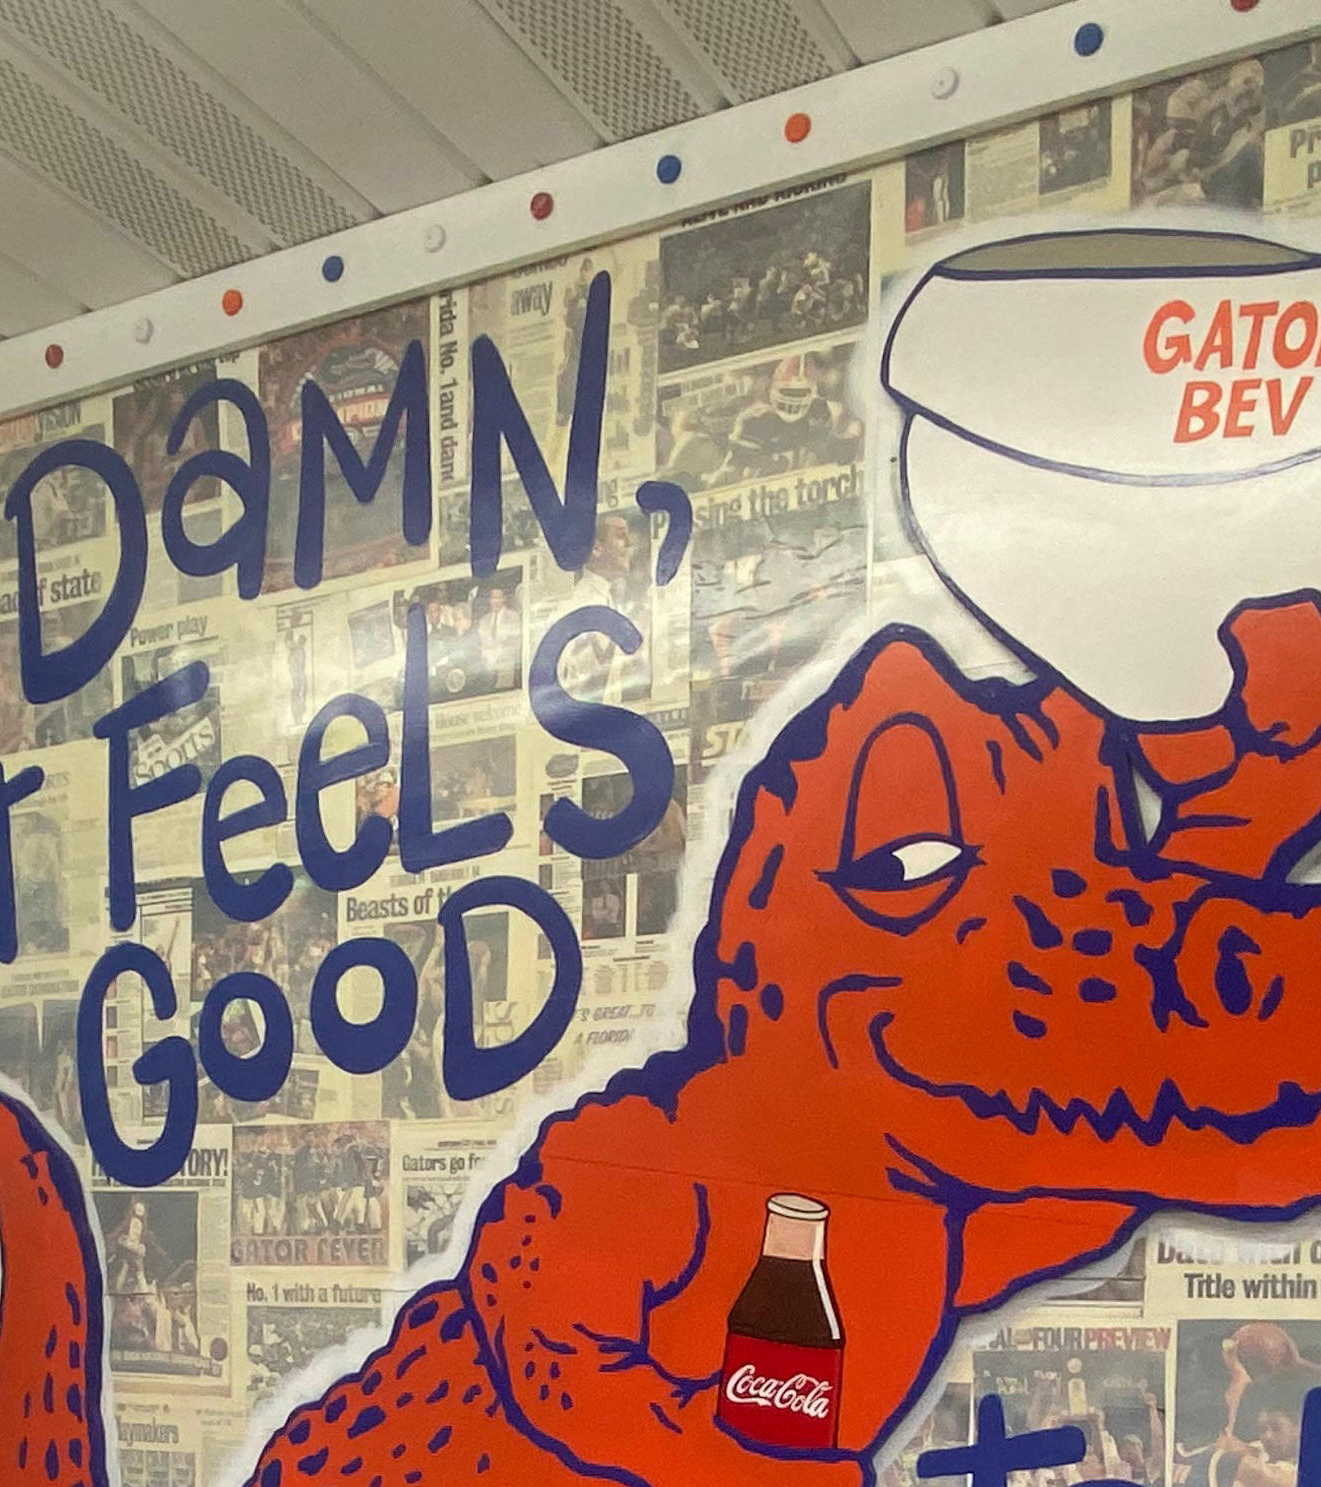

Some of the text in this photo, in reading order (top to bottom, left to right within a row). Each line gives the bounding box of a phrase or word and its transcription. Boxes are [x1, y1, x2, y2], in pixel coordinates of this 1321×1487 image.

[1173, 376, 1314, 443] BEV
[347, 893, 409, 923] Beasts
[414, 887, 434, 915] of
[402, 1154, 447, 1173] Gators
[449, 1156, 466, 1175] go
[246, 1282, 269, 1303] No.
[283, 1282, 316, 1303] with
[1184, 1273, 1236, 1299] Title
[1242, 1273, 1318, 1299] within
[1084, 1327, 1172, 1351] PREVIEW
